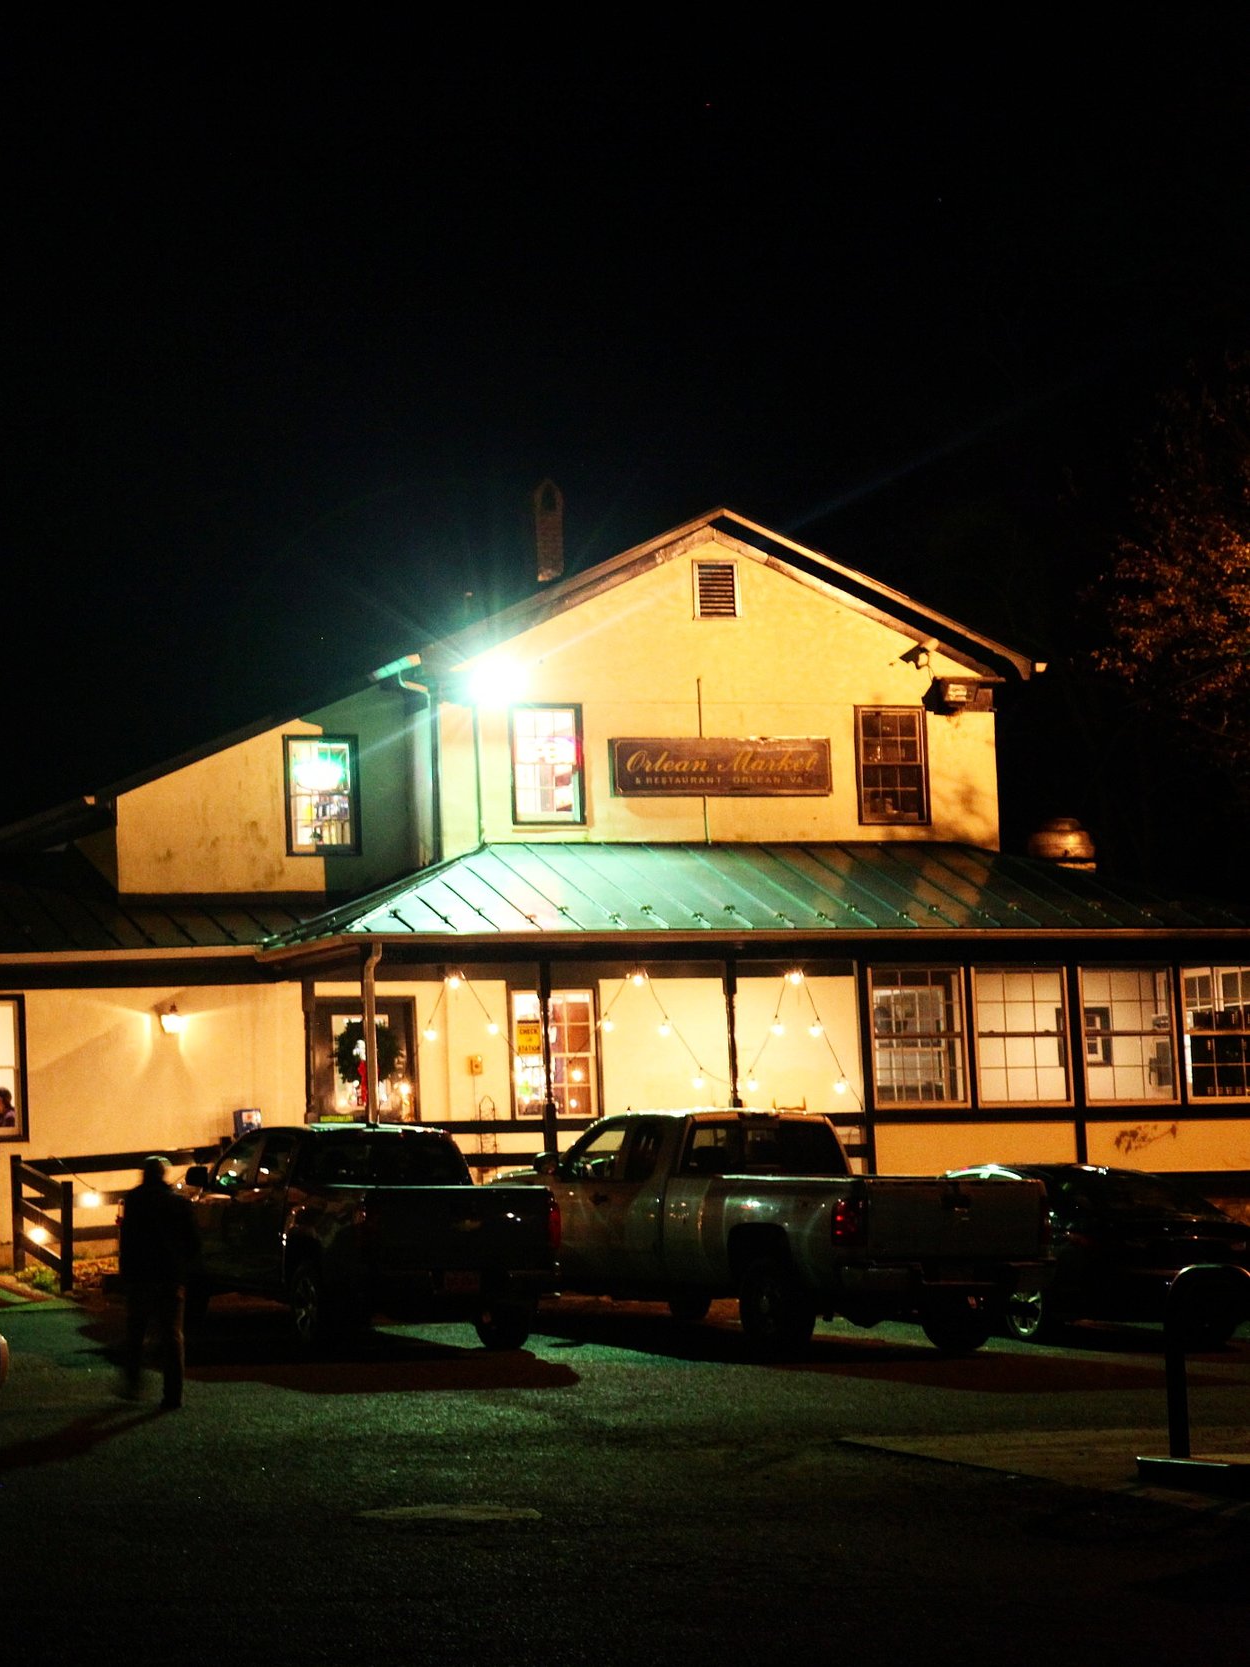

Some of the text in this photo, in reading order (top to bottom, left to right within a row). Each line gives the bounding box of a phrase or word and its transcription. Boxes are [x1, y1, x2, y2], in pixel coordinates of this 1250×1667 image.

[626, 750, 819, 773] Orlean Market
[646, 777, 721, 785] RESTAURANT
[732, 777, 781, 785] ORLEAN
